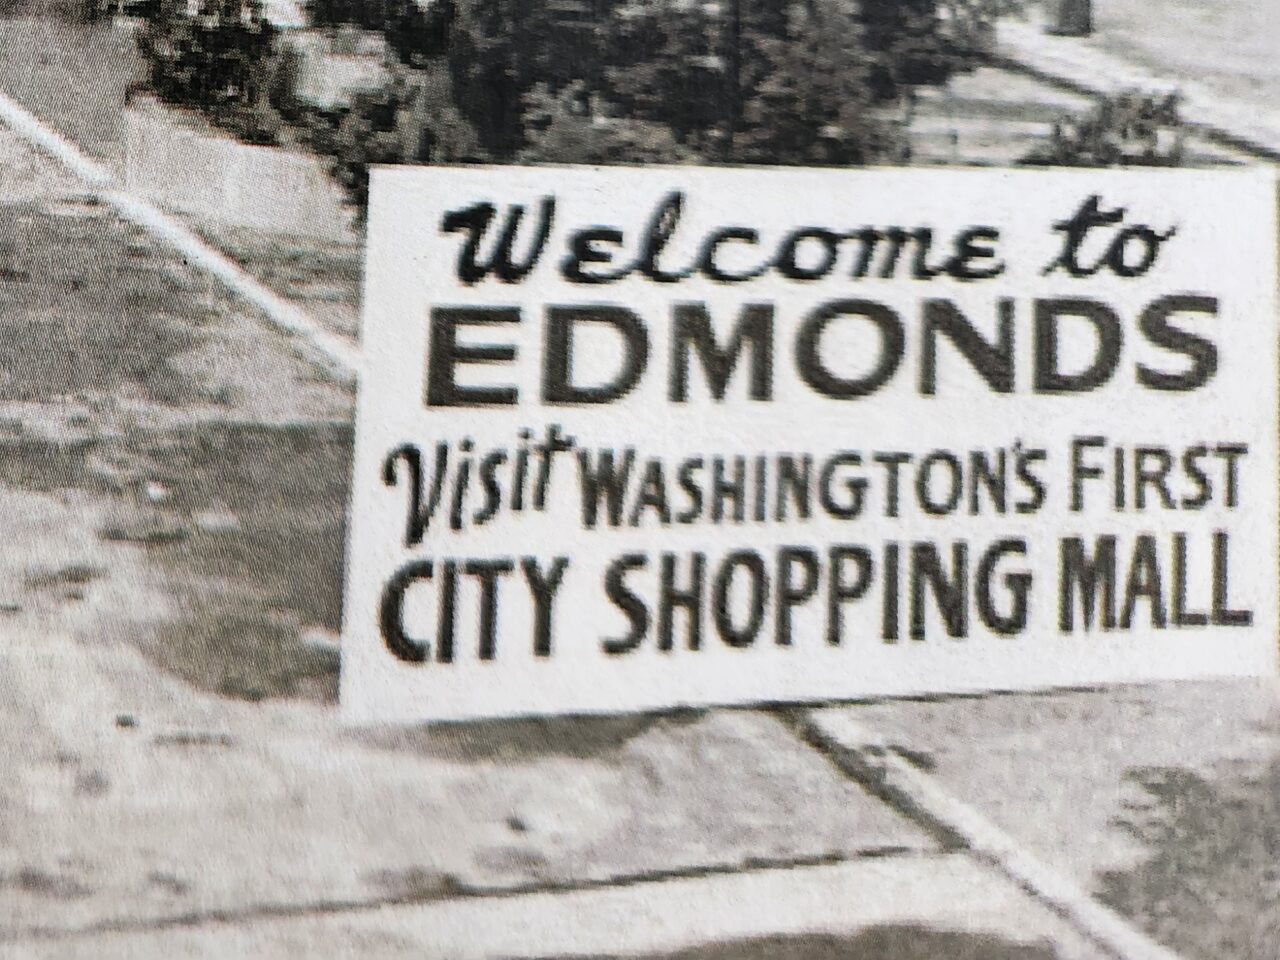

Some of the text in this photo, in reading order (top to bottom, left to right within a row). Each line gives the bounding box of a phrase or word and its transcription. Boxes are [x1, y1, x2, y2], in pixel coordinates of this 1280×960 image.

[439, 190, 1177, 289] Welcome to
[423, 292, 1221, 410] EDMONDS
[380, 423, 1251, 546] Visit WASHINGTON'S FIRST
[377, 530, 1254, 666] CITY SHOPPING MALL
